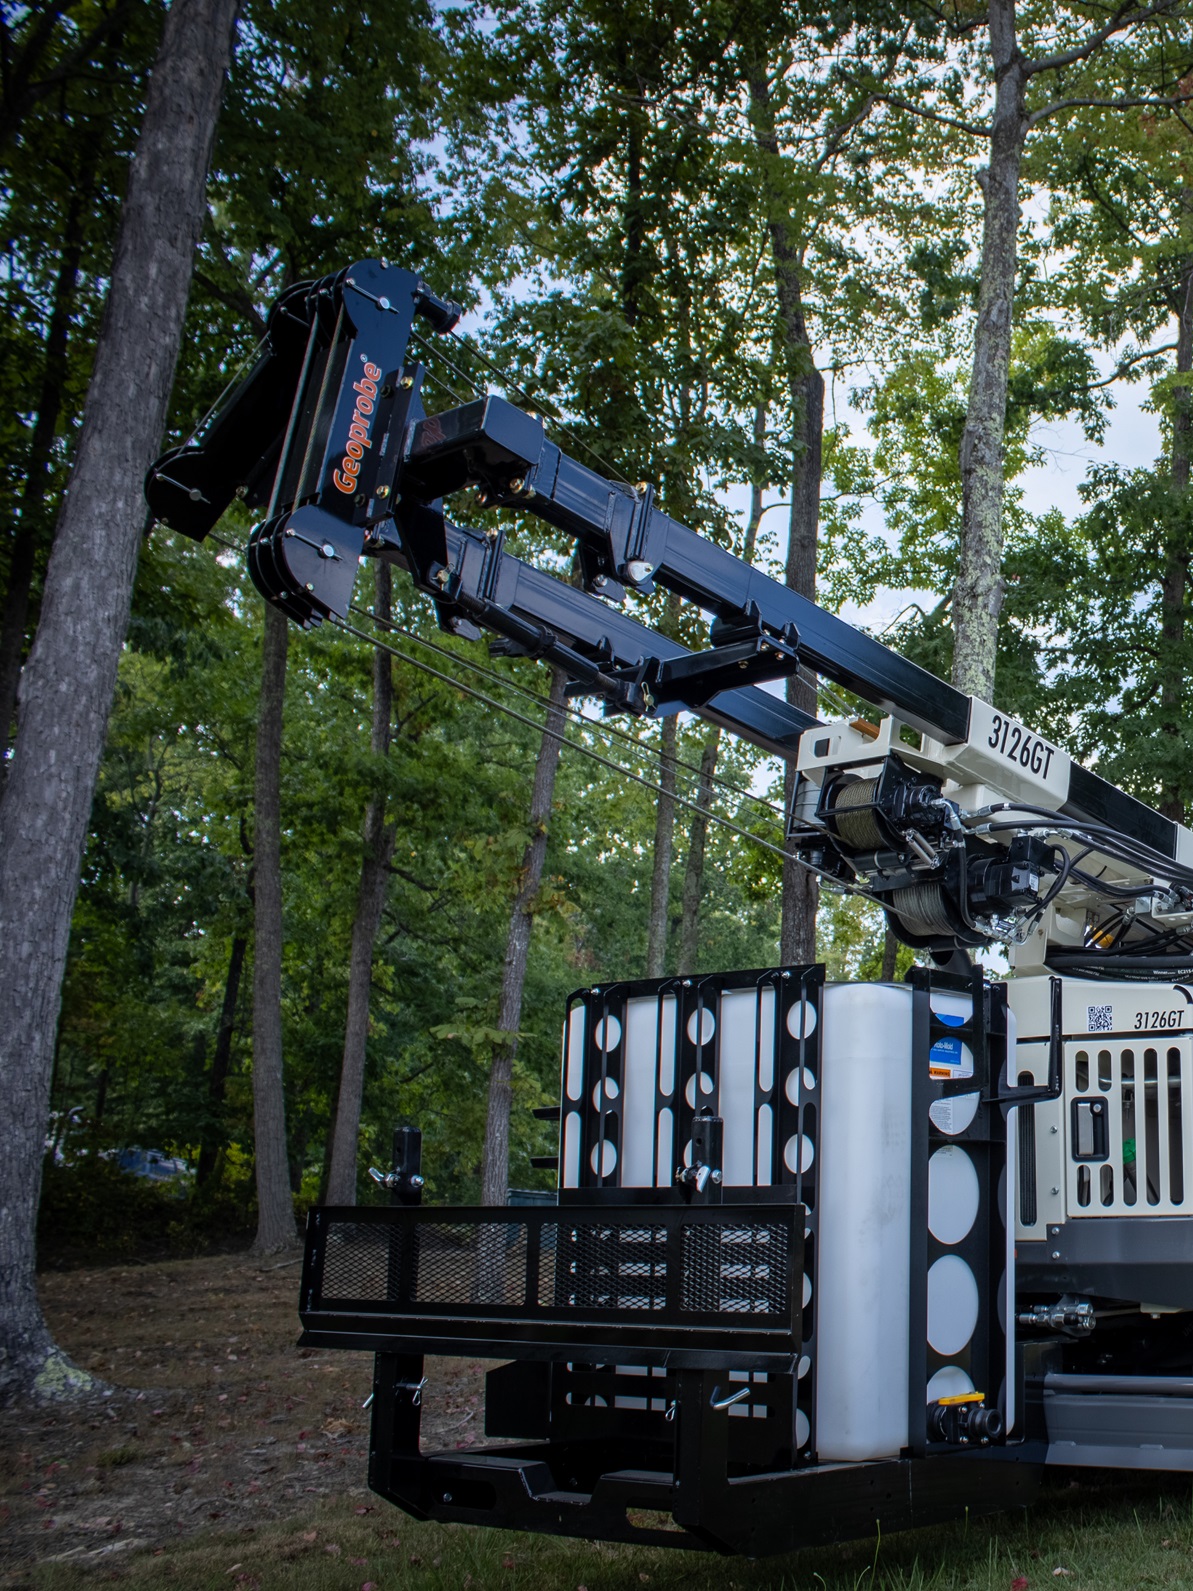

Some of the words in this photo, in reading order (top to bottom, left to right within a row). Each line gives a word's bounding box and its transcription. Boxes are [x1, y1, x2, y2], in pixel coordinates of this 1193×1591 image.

[333, 361, 382, 495] Geoprobe
[988, 714, 1055, 780] 3126GT
[1134, 1010, 1184, 1029] 3126GT
